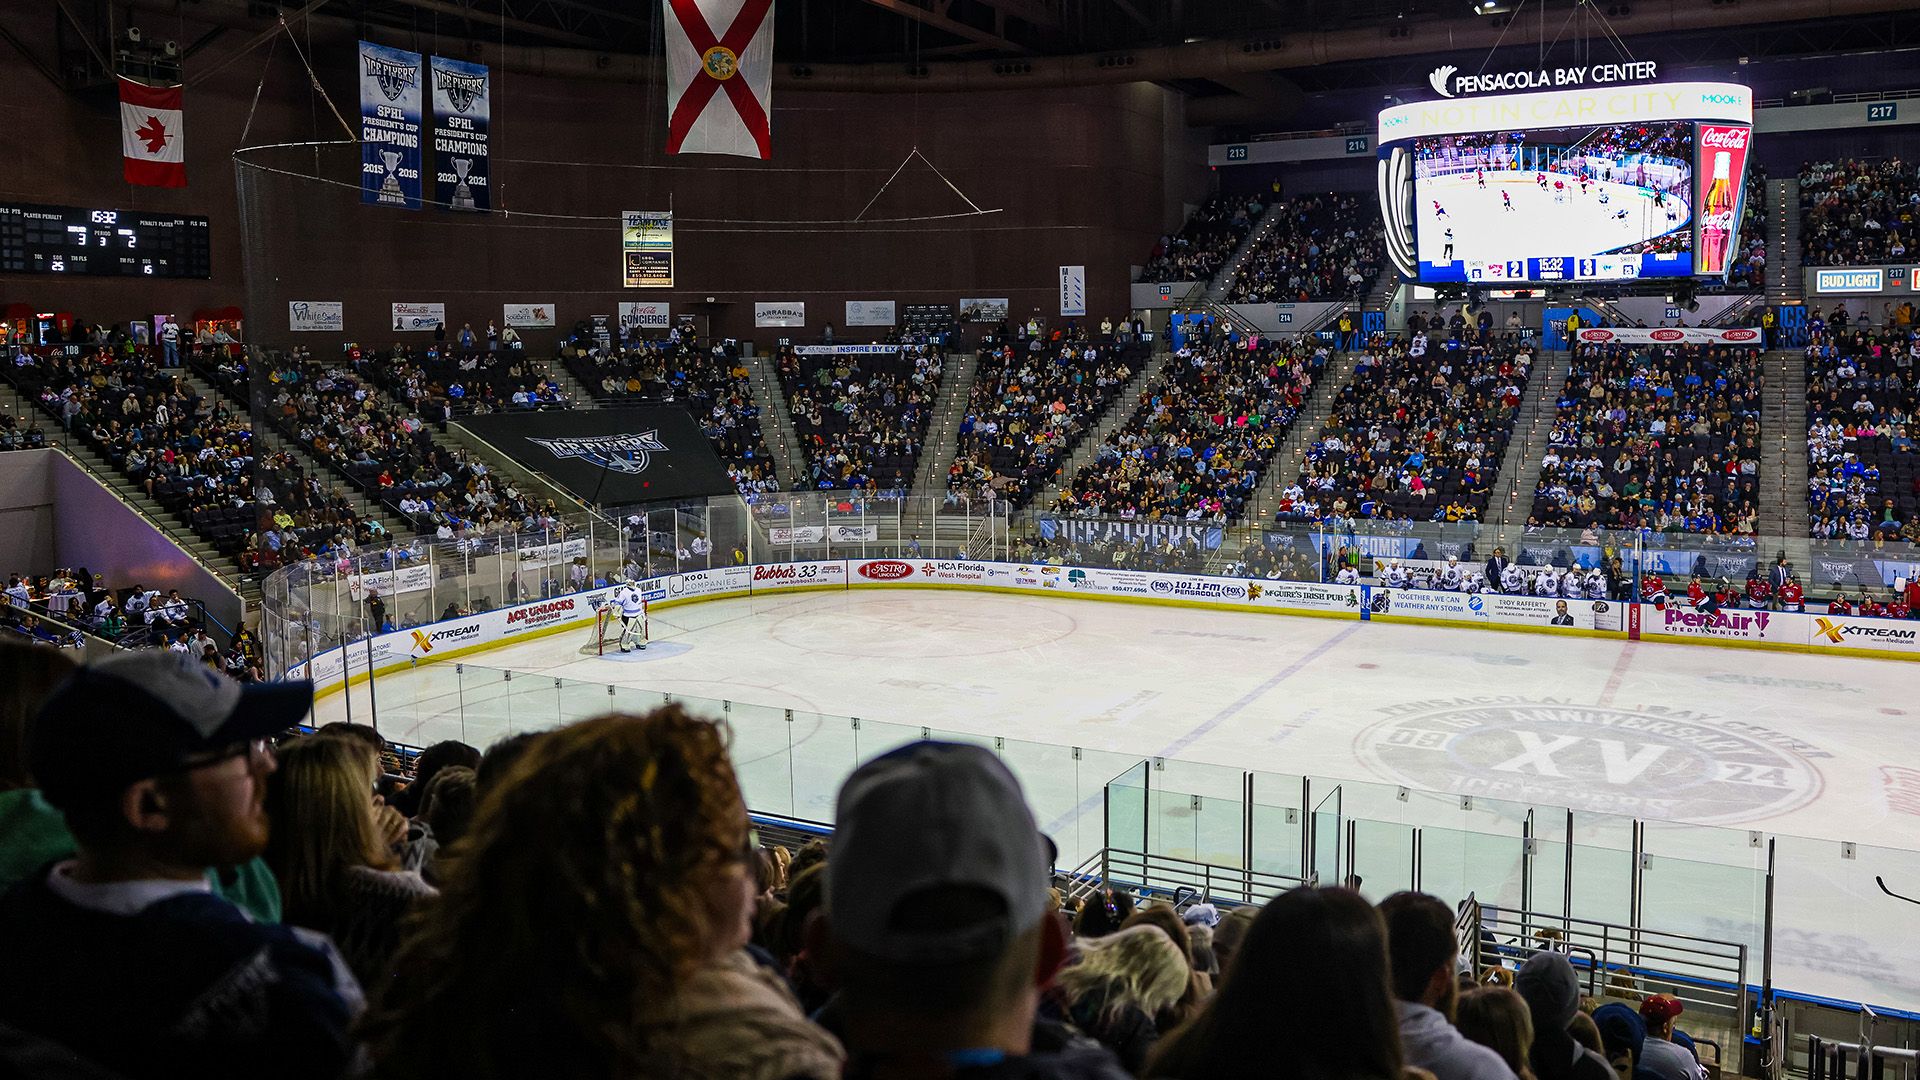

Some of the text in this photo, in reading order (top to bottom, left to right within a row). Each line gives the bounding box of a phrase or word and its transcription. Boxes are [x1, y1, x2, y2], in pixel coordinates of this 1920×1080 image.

[364, 56, 418, 85] ICE FLYERS
[434, 70, 485, 96] ICE FLYERS
[1456, 61, 1657, 94] PENSACOLA BAY CENTER
[377, 105, 404, 120] SPHL
[1422, 90, 1683, 128] NOT IN CAR CITY
[1871, 106, 1893, 118] 217
[362, 116, 418, 132] PRESIDENT'S CUP
[448, 116, 474, 130] SPHL
[363, 127, 418, 148] CHAMPIONS
[434, 128, 488, 142] PRESIDENT'S CUP
[1701, 128, 1748, 148] Coca-Cola
[435, 138, 488, 156] CHAMPIONS
[1349, 141, 1365, 150] 214
[1229, 149, 1245, 158] 213
[363, 162, 384, 174] 2015
[398, 168, 418, 179] 2016
[438, 172, 458, 183] 2020
[468, 176, 487, 186] 2021
[92, 210, 117, 224] 15:32
[78, 234, 86, 246] 3
[99, 237, 106, 247] 3
[128, 236, 137, 248] 2
[51, 262, 64, 271] 25
[144, 265, 152, 274] 15
[1510, 262, 1520, 278] 2
[1538, 258, 1564, 271] 15:32
[1583, 259, 1593, 275] 3
[1890, 269, 1903, 278] 217
[1822, 274, 1879, 287] BUD LIGHT
[621, 314, 668, 324] CONCIERGE
[756, 309, 803, 318] CARRABBA'S
[1667, 308, 1680, 318] 216
[1780, 306, 1806, 328] ICE
[1362, 312, 1384, 332] ICE
[1522, 329, 1534, 338] 115
[778, 338, 789, 346] 112
[65, 345, 79, 355] 108
[538, 432, 662, 456] ICE FLYERS
[754, 565, 817, 581] Bubba's 33
[871, 564, 907, 574] ASTRO
[958, 564, 985, 572] Florida
[655, 579, 661, 589] AT
[685, 574, 708, 582] KOOL
[685, 578, 738, 591] COMPANIES
[1175, 581, 1201, 590] 101.1
[1174, 589, 1221, 598] PENSACOLA
[1303, 592, 1324, 600] IRISH
[506, 608, 528, 624] ACE
[1665, 609, 1752, 630] PenAir
[430, 624, 480, 642] XTREAM
[1665, 626, 1704, 634] CREDIT
[1842, 625, 1916, 639] XTREAM
[1374, 695, 1560, 716] PENSACOLA
[1386, 728, 1448, 748] 09
[1509, 710, 1764, 755] ANNIVERSARY
[1724, 764, 1790, 786] 24
